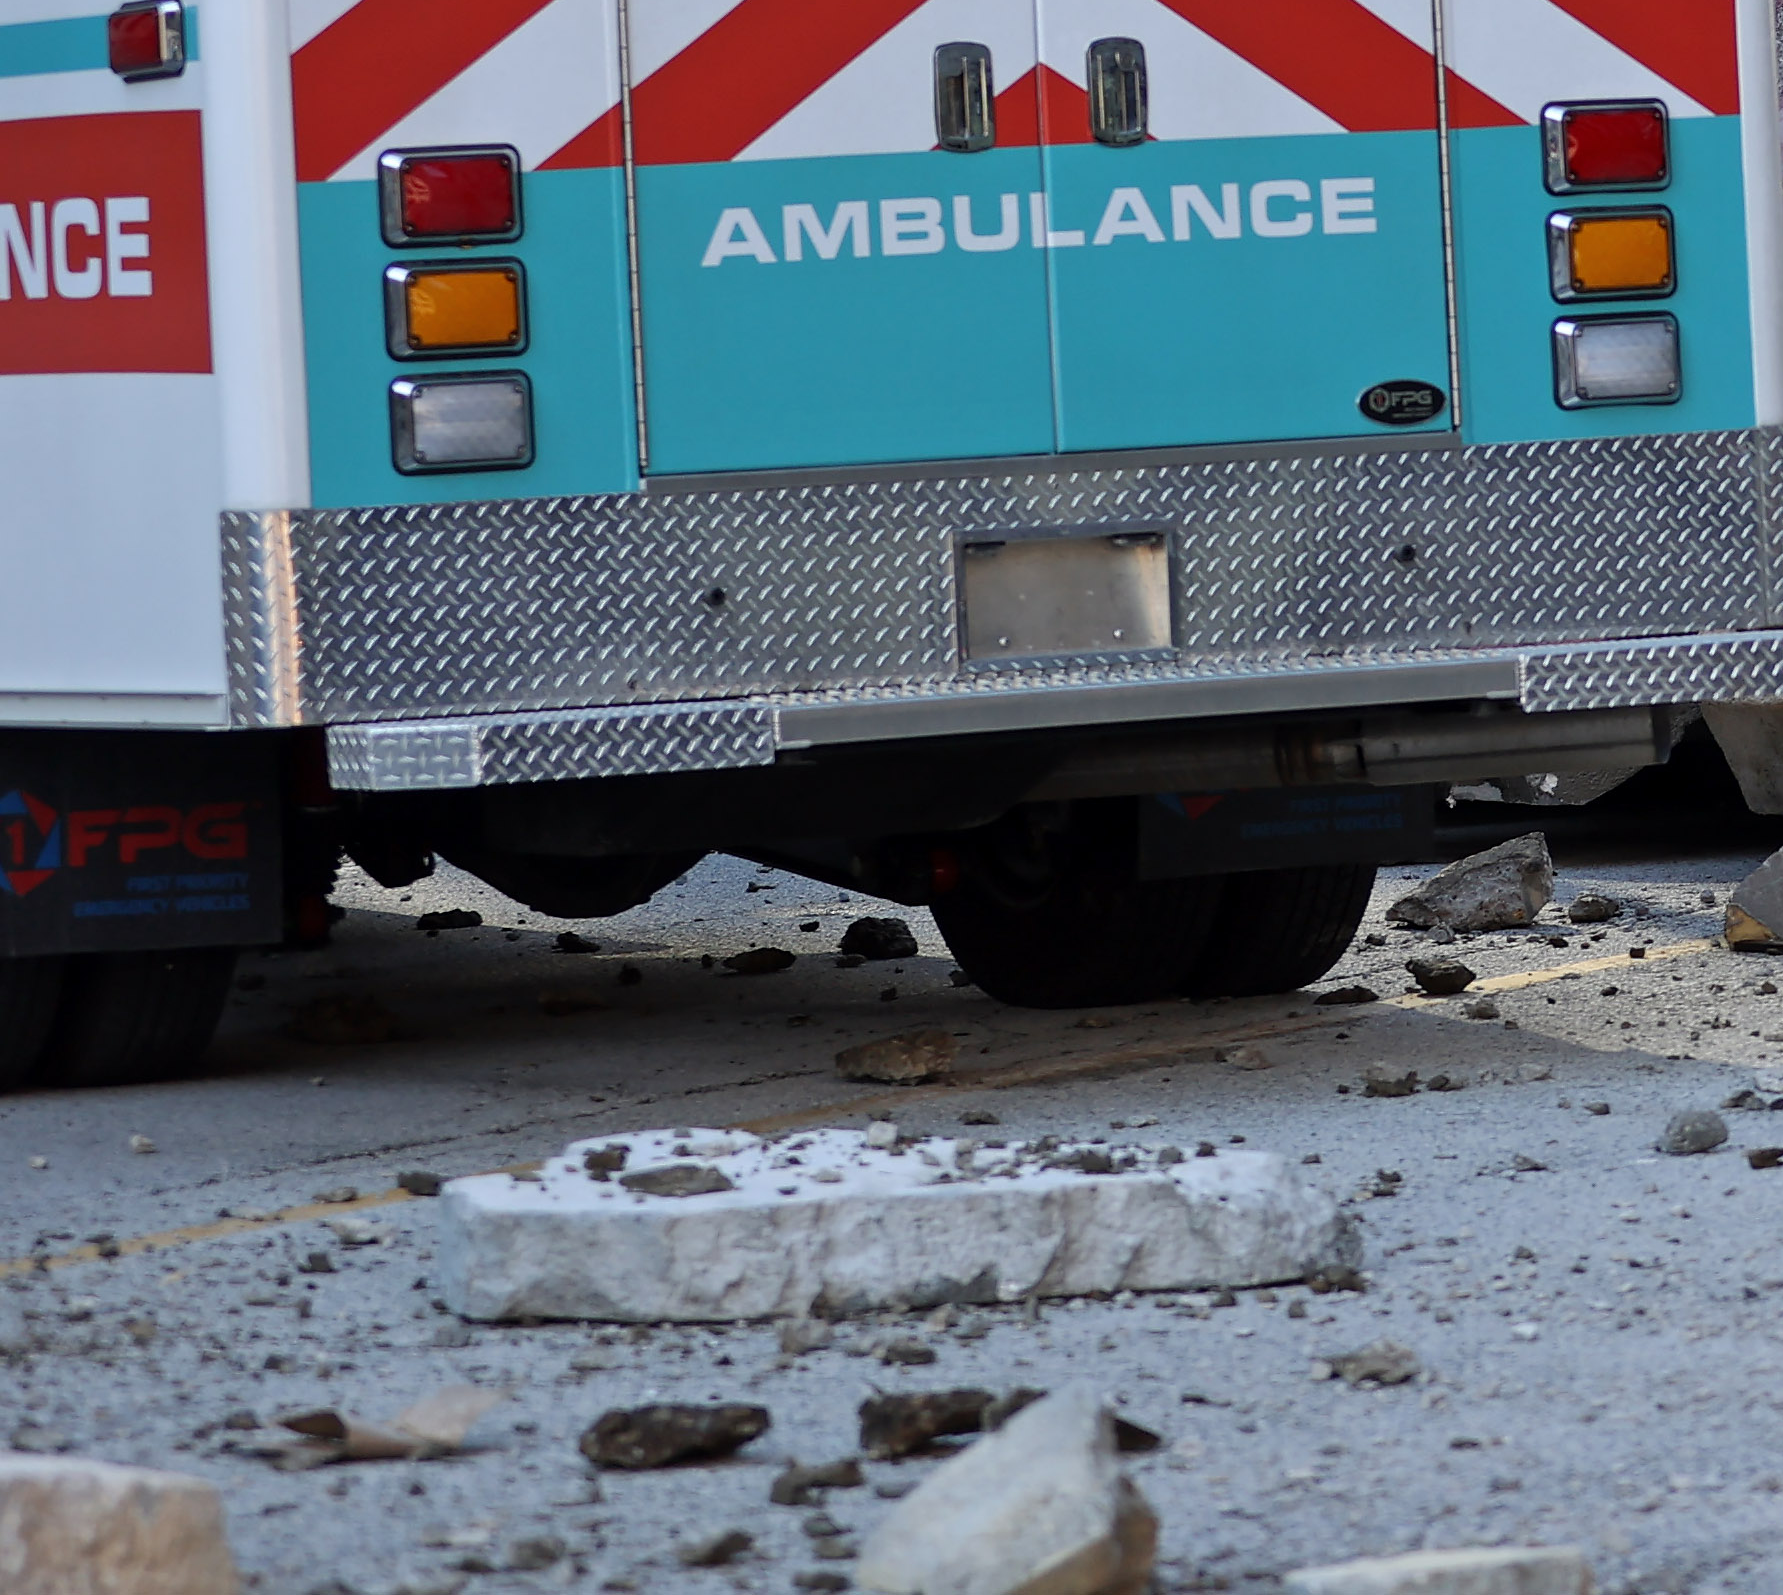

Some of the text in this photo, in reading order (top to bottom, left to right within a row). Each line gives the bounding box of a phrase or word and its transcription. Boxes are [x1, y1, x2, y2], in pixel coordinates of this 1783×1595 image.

[0, 196, 153, 301] NCE
[700, 177, 1379, 267] AMBULANCE
[1390, 390, 1433, 406] FPG
[66, 802, 250, 868] FPG
